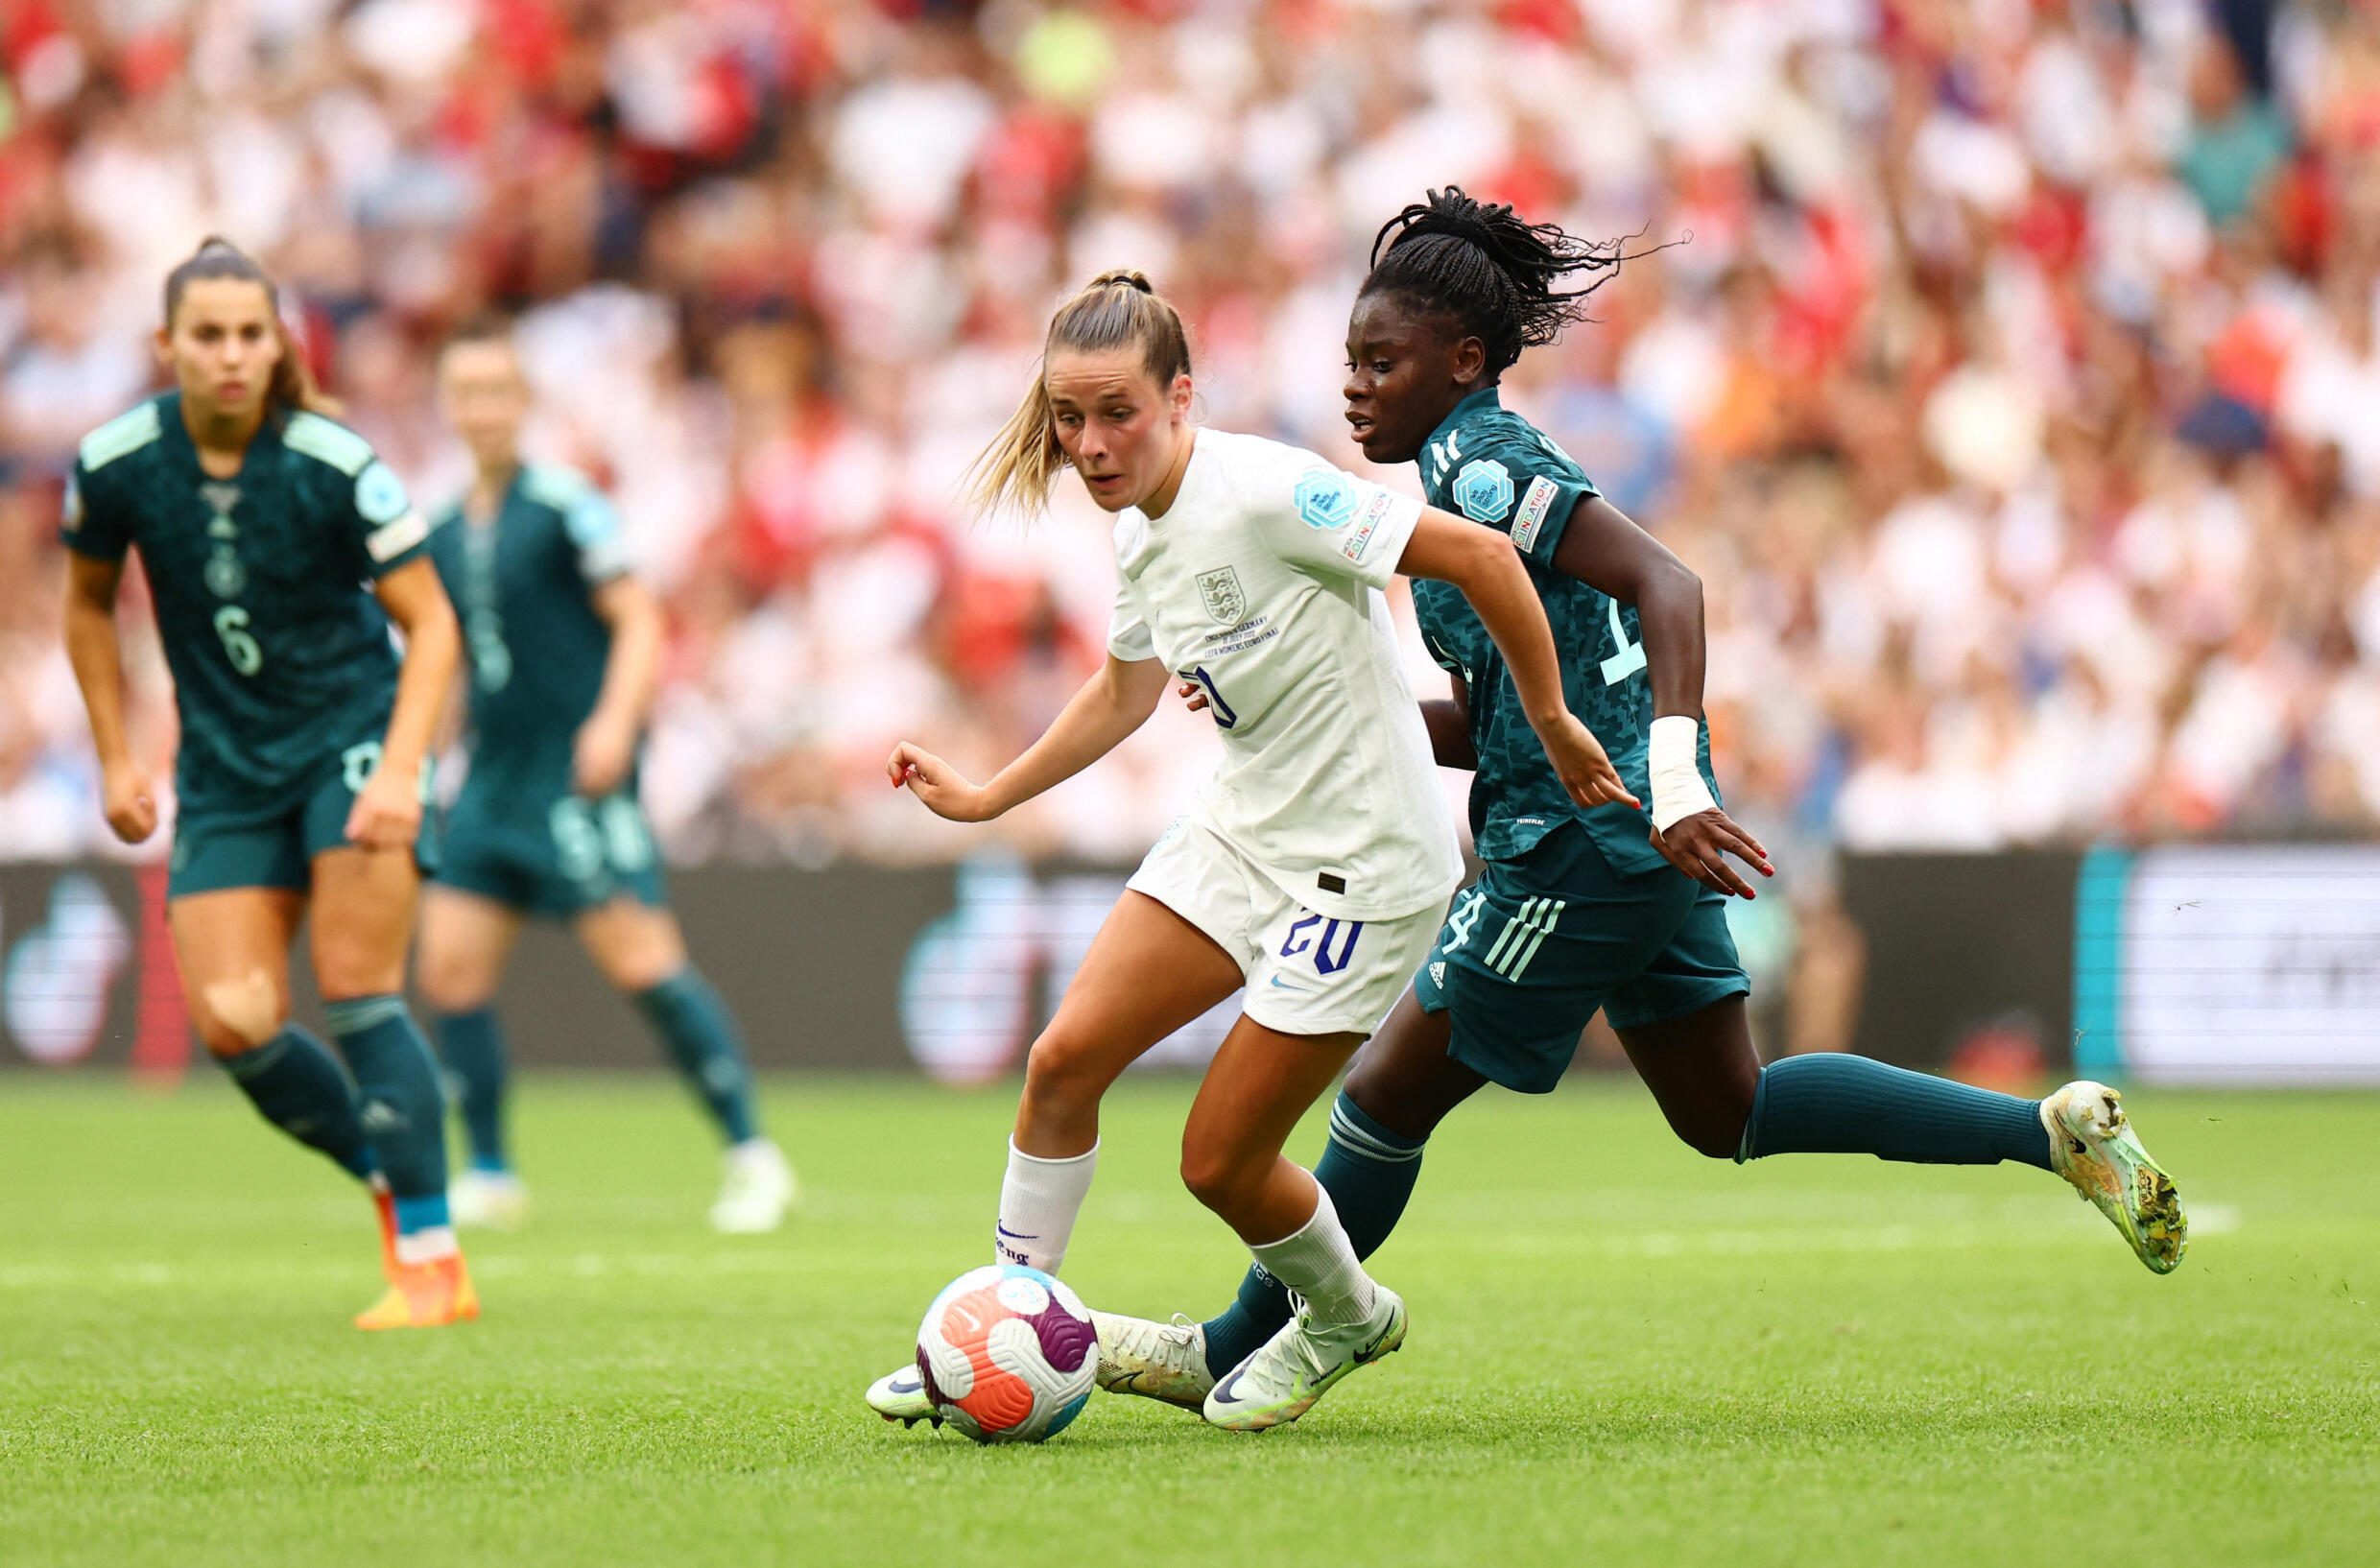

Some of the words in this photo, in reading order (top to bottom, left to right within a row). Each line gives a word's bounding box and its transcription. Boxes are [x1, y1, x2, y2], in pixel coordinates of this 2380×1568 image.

[1346, 492, 1387, 559] FOUNDATION
[1516, 481, 1550, 548] FOUNDATION
[213, 605, 263, 677] 6
[1218, 642, 1245, 655] WOMENS
[1244, 637, 1261, 648] EURO
[1238, 615, 1267, 632] GERMANY
[1280, 906, 1365, 975] 20
[1441, 889, 1488, 956] 4
[1253, 1259, 1275, 1288] das
